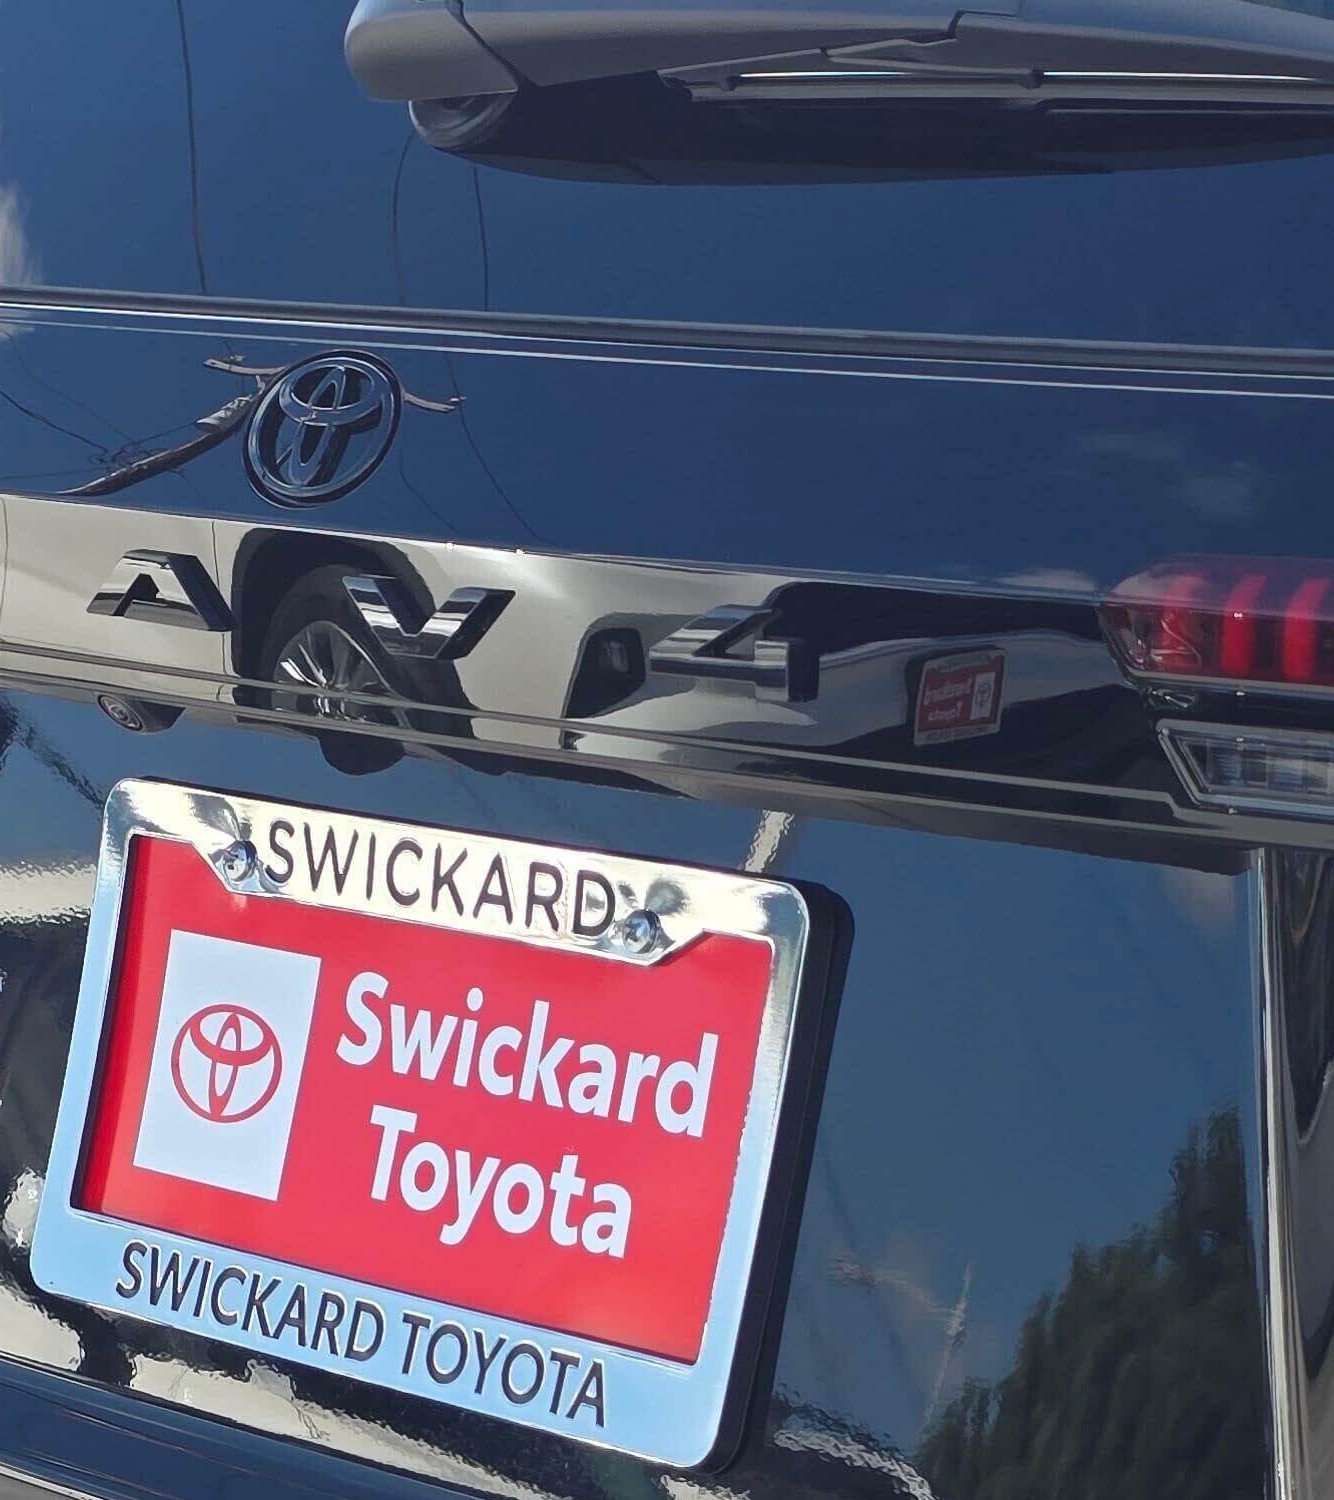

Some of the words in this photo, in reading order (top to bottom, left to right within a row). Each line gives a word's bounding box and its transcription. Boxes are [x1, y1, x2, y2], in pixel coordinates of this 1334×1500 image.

[266, 818, 616, 937] SWICKARD
[336, 971, 720, 1138] Swickard
[369, 1104, 633, 1259] Toyota
[115, 1240, 384, 1362] SWICKARD
[399, 1312, 607, 1428] TOYOTA
